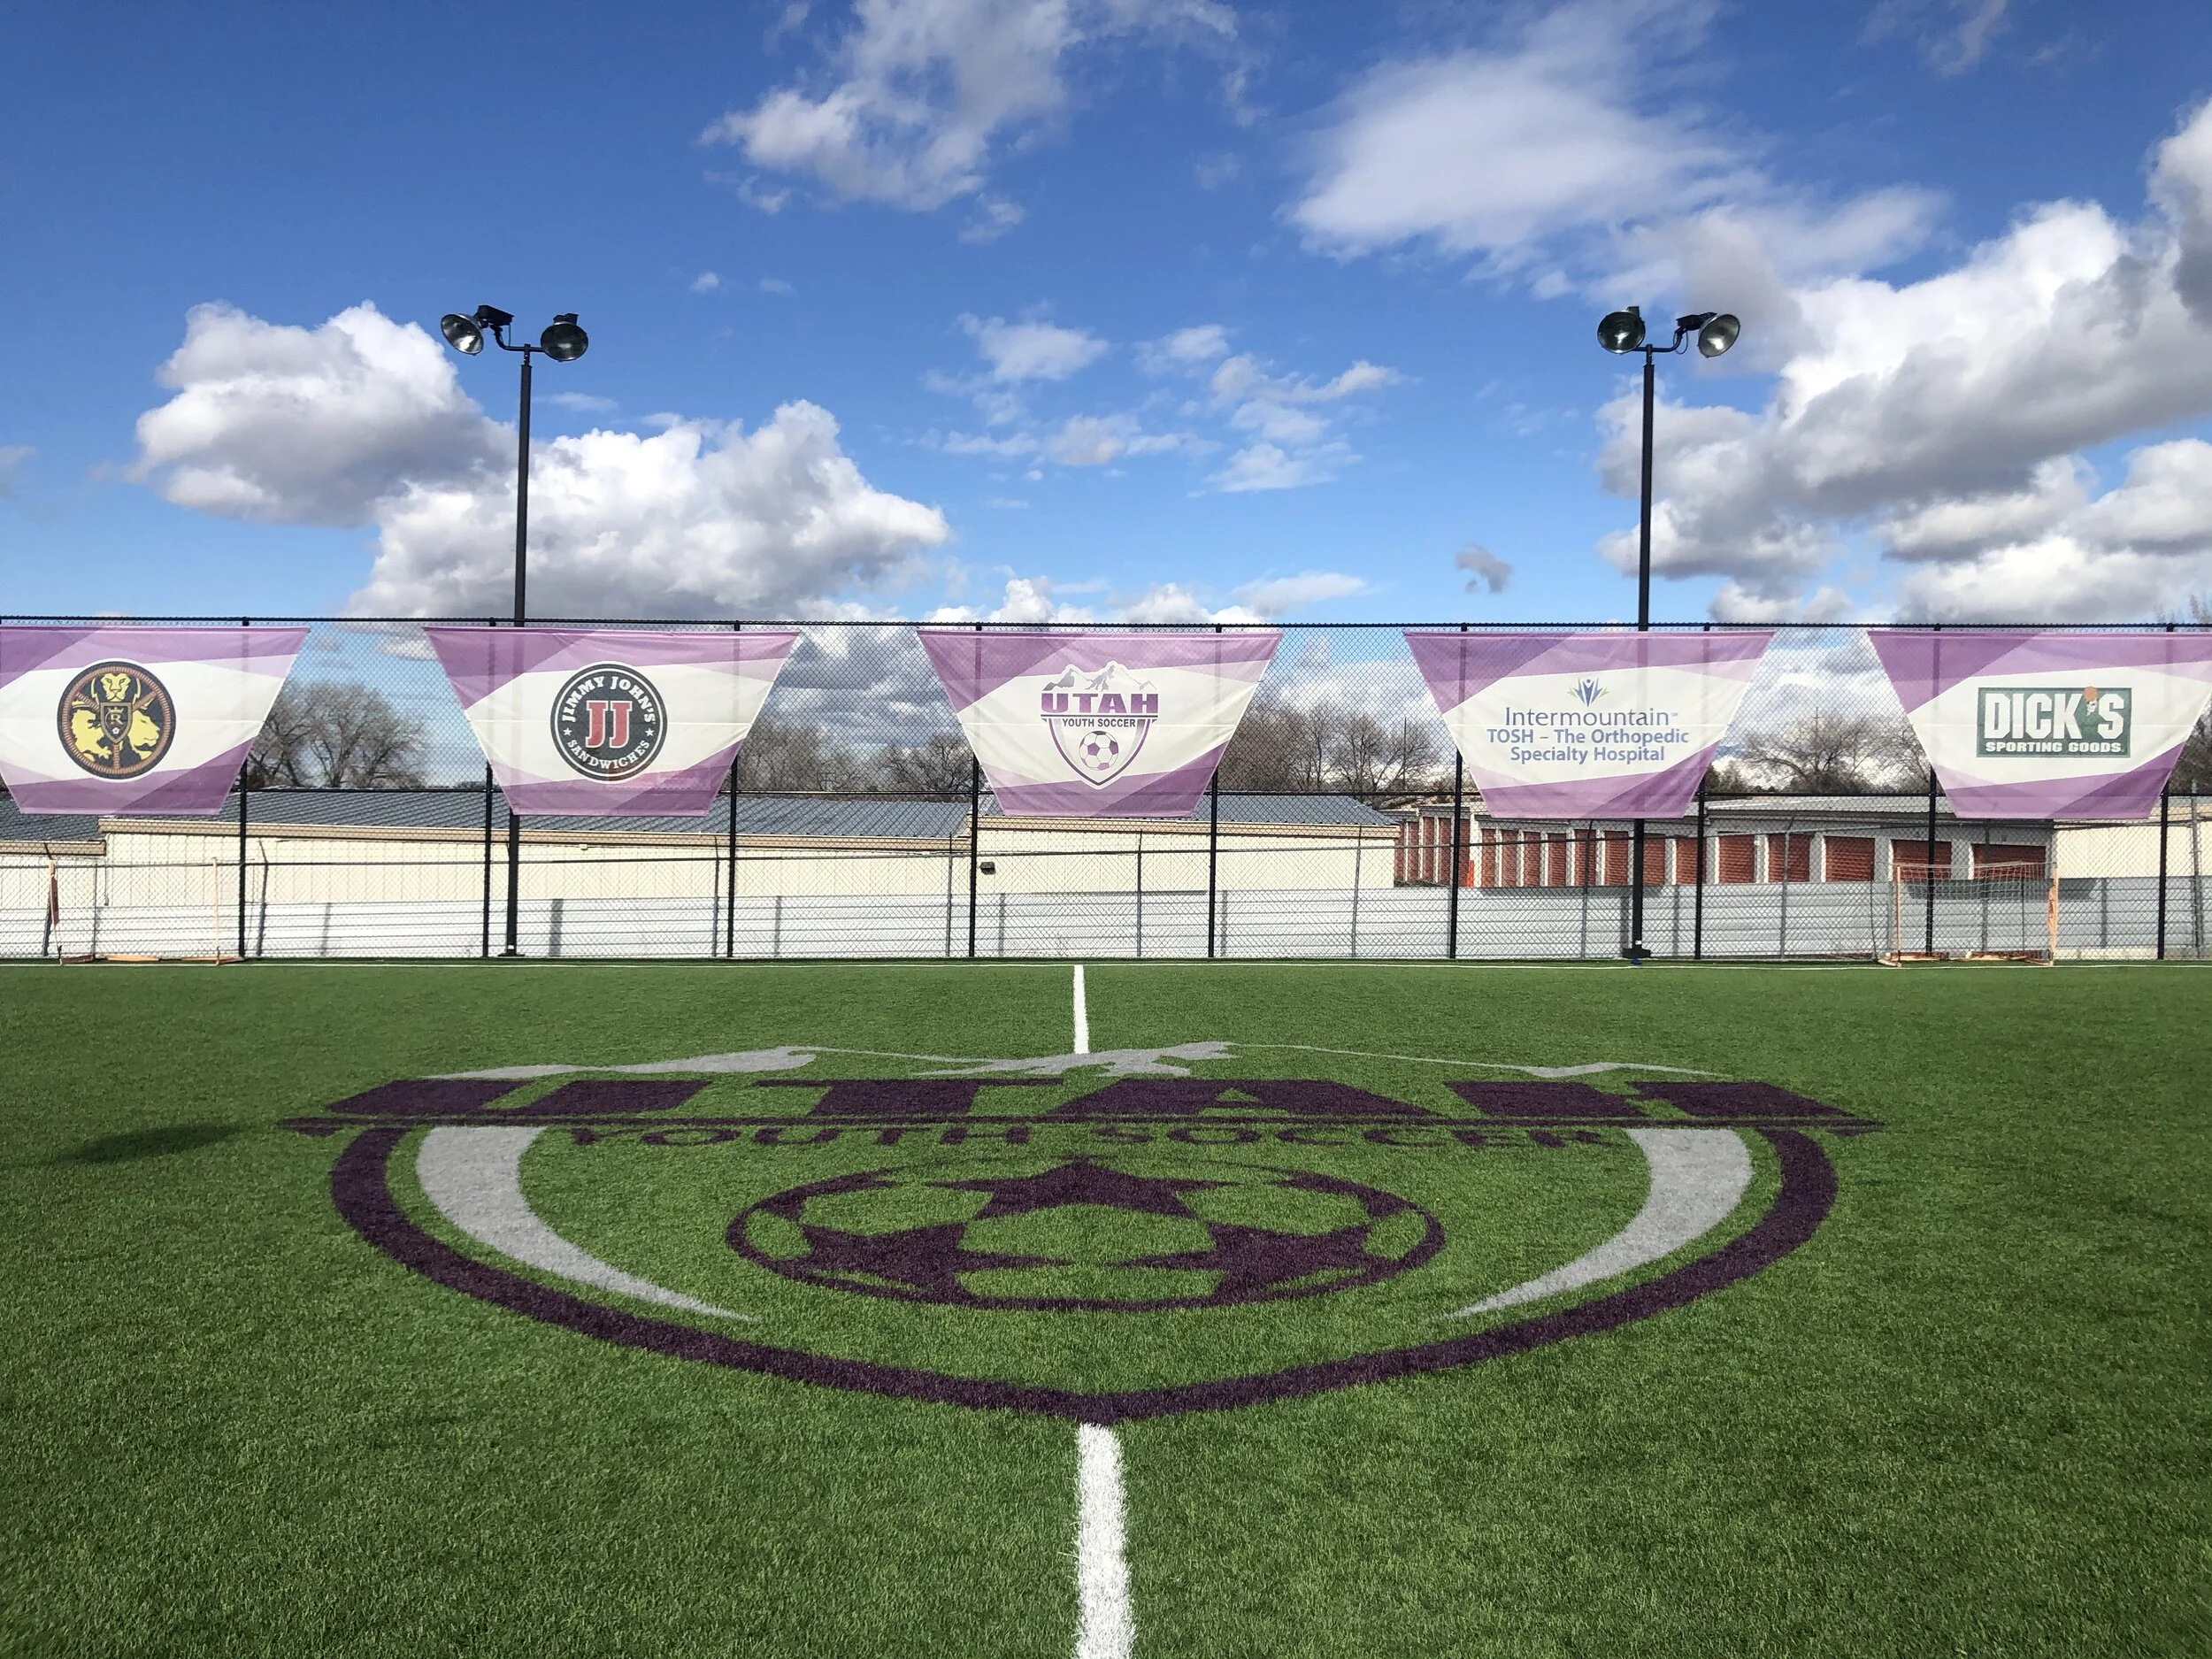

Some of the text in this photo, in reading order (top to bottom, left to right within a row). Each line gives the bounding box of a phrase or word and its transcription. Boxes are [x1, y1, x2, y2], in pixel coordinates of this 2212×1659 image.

[562, 676, 656, 723] JIMMY JOHN'S
[1041, 693, 1158, 713] UTAH
[585, 700, 633, 749] JJ
[1062, 718, 1136, 727] YOUTH SOCCER
[1505, 707, 1670, 726] Intermountain
[1486, 729, 1534, 743] TOSH
[1554, 729, 1586, 743] The
[1590, 728, 1689, 747] Orthopedic
[1985, 741, 2122, 753] SPORTING GOODS
[567, 740, 649, 769] SANDWICHES
[1510, 747, 1664, 764] Specialty Hospital
[326, 1079, 1856, 1118] UTAH
[570, 1125, 1617, 1148] YOUTH SOCCER
